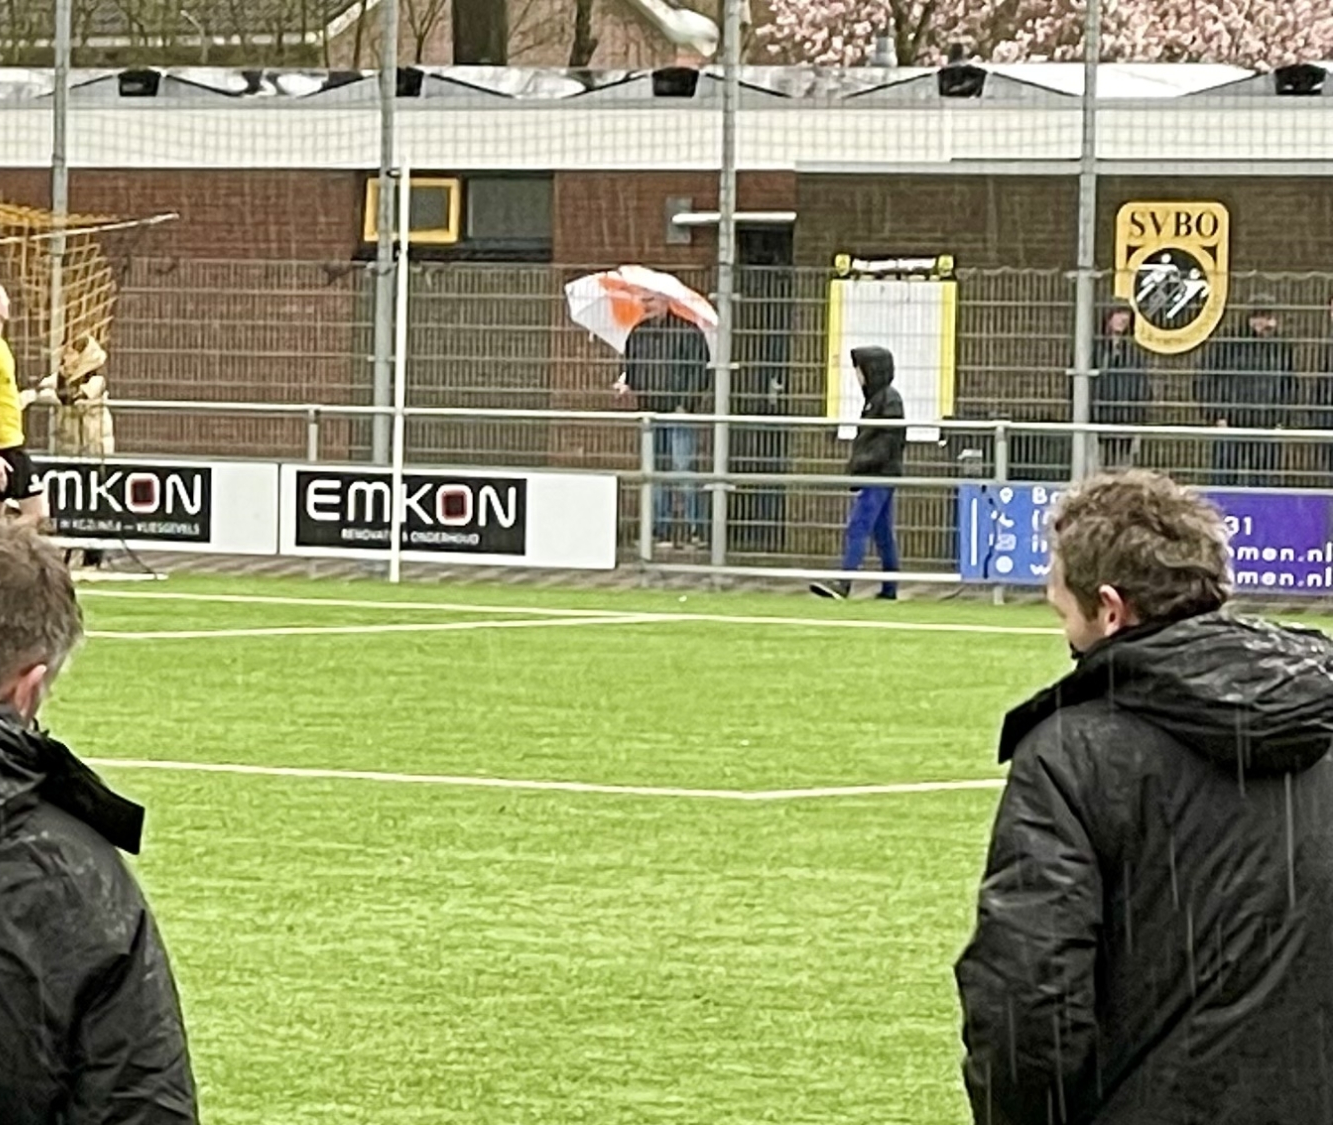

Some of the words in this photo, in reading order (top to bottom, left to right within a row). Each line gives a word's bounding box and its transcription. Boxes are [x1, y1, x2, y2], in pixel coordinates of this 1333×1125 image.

[1129, 210, 1219, 239] SVBO
[42, 469, 202, 516] MKON
[305, 478, 518, 530] EMKON
[409, 532, 480, 545] ONDERHOUD
